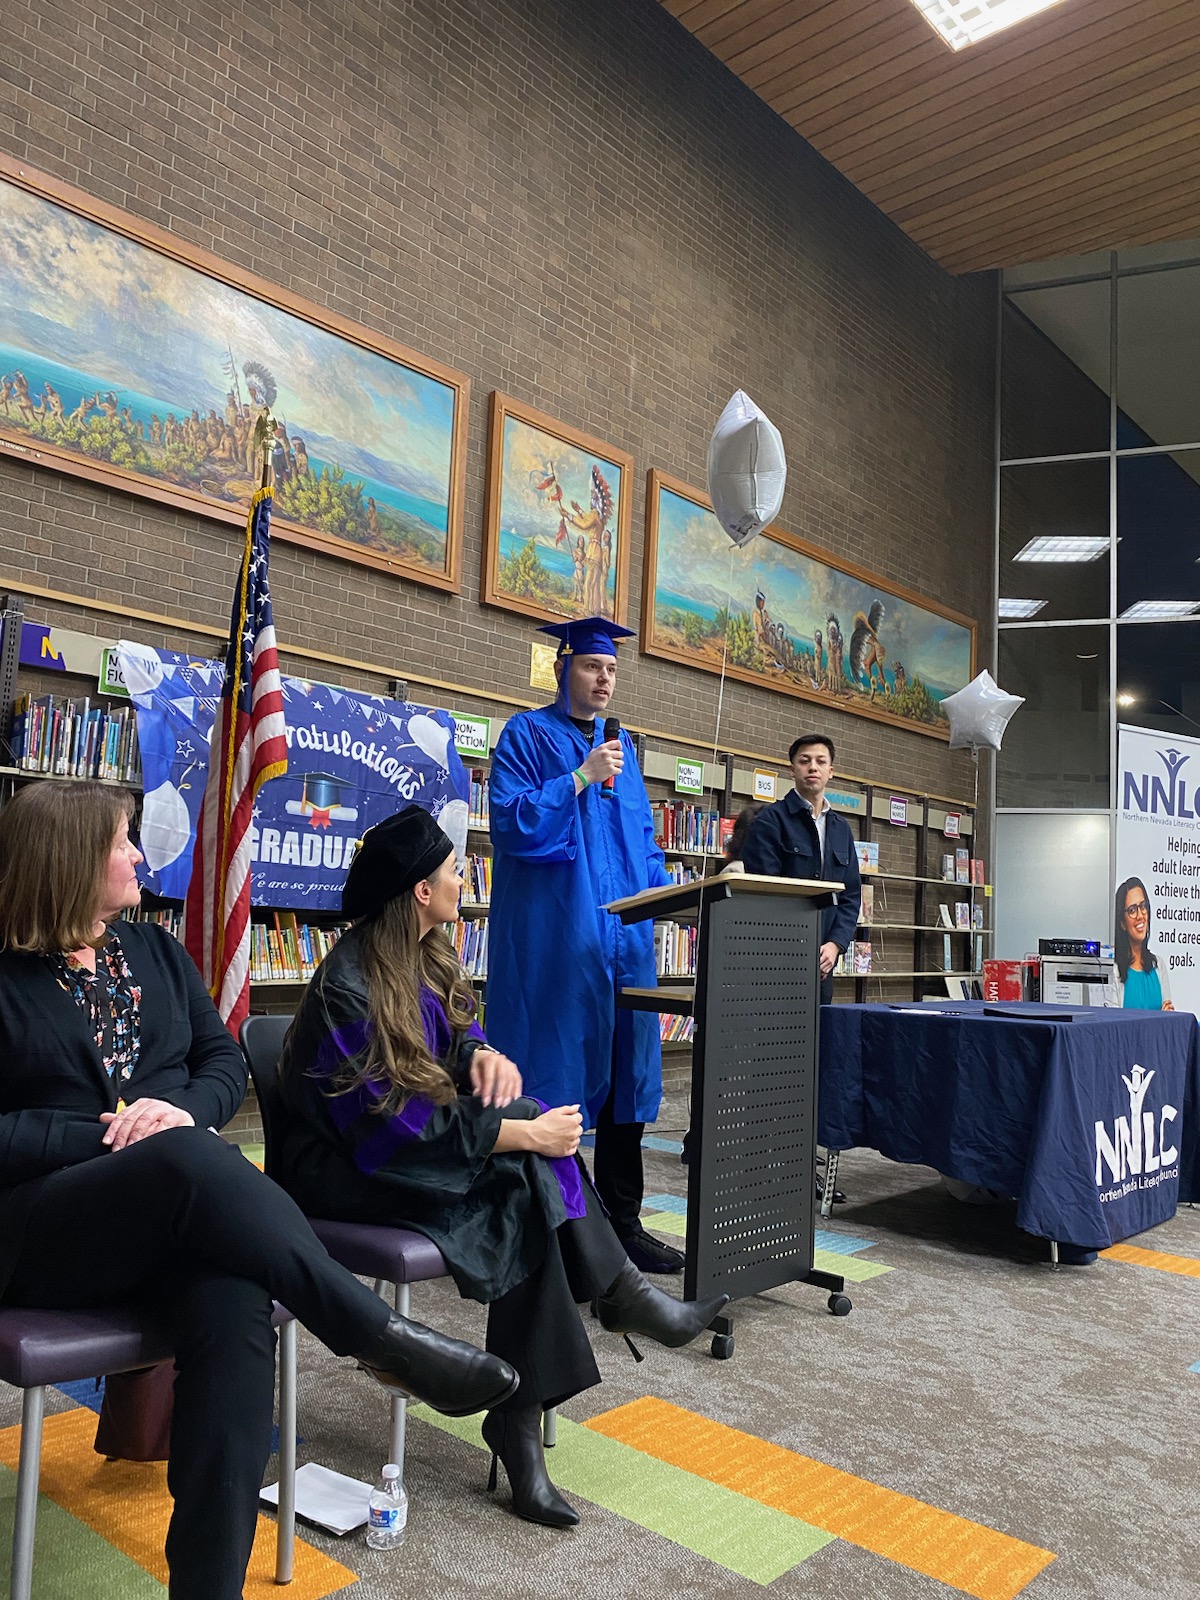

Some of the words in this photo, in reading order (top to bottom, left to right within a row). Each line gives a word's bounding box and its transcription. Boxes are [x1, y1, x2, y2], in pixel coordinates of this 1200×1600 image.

[678, 765, 694, 776] NON-
[678, 775, 701, 787] FICTION
[1123, 812, 1149, 823] Northern
[1150, 816, 1172, 826] Nevada
[1173, 820, 1196, 831] Literacy
[1152, 858, 1177, 874] adult
[268, 881, 289, 890] are
[290, 880, 305, 890] so
[1154, 881, 1189, 899] achieve
[1158, 928, 1176, 944] and
[1169, 951, 1196, 970] goals.
[1094, 1104, 1179, 1187] NNLC
